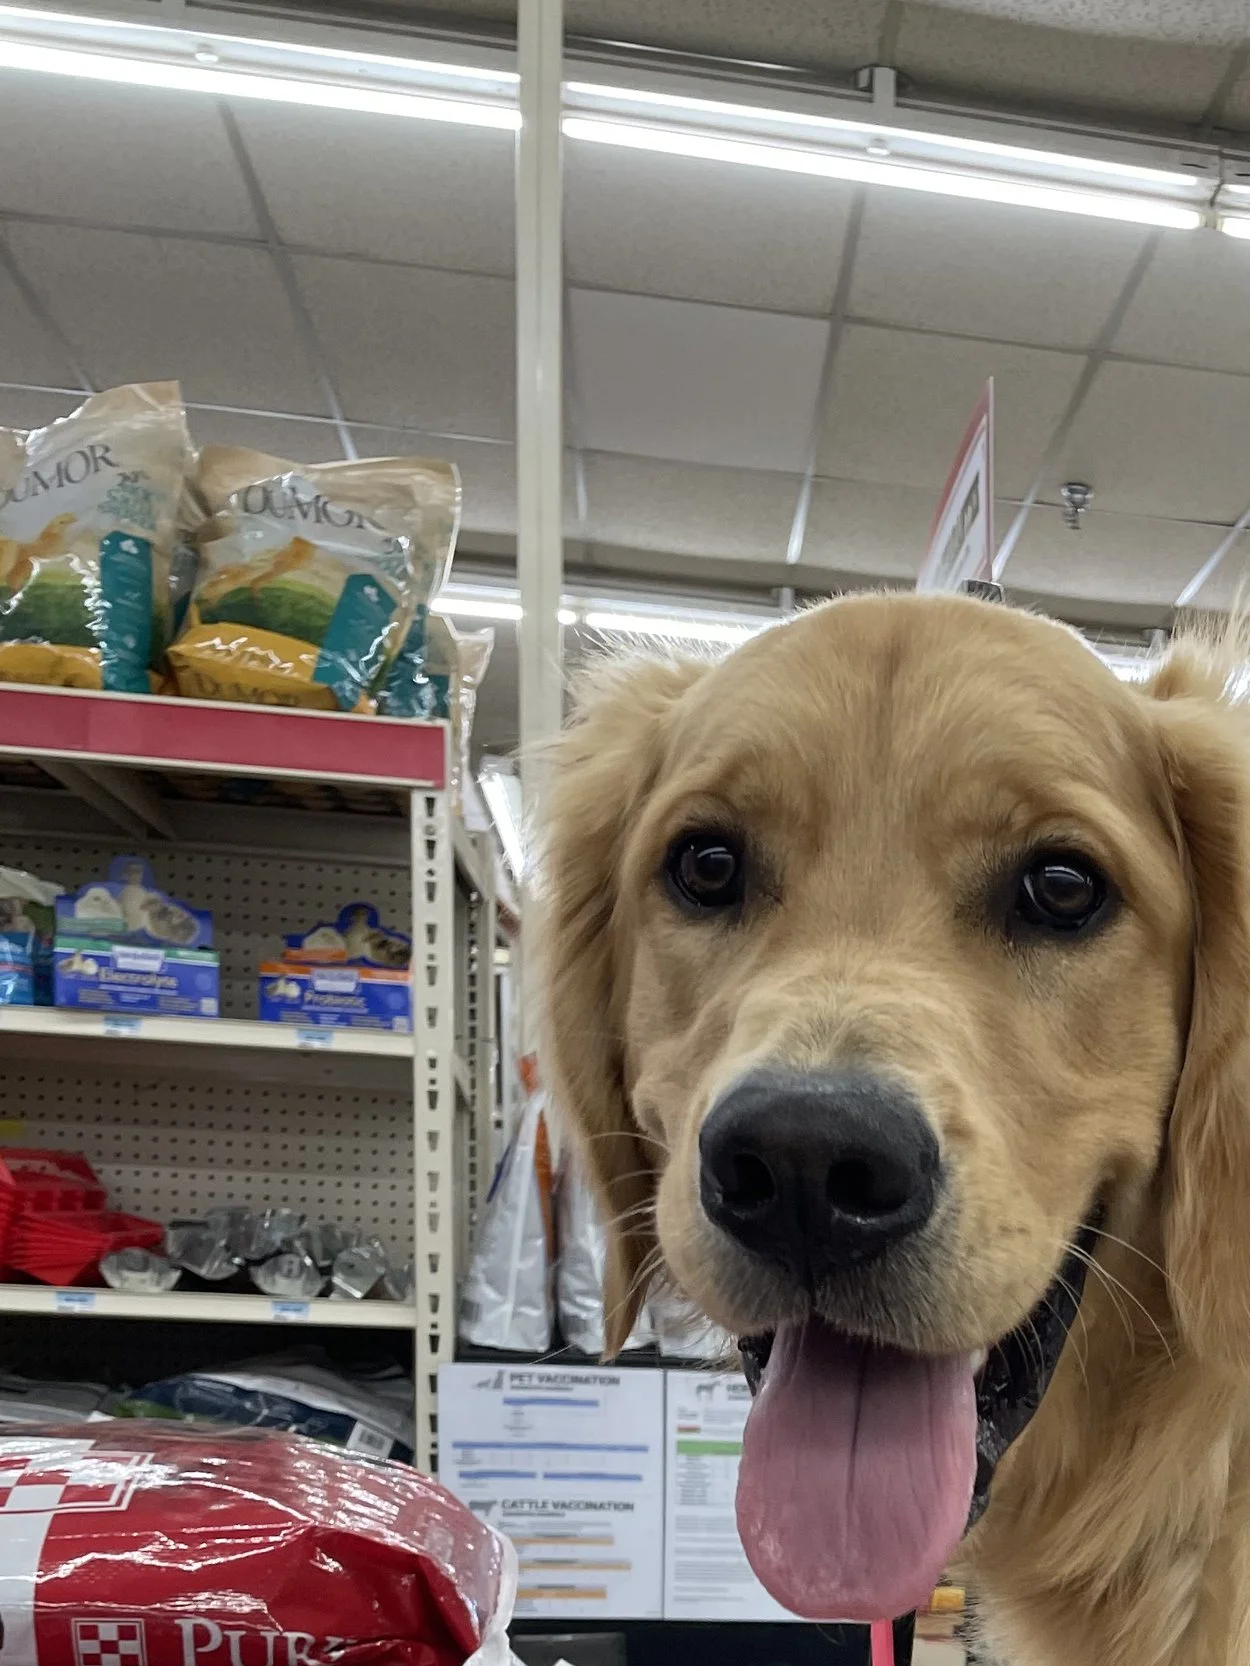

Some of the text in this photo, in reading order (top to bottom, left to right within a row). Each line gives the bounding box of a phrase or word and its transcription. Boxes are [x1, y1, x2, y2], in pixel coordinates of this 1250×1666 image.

[7, 443, 121, 505] UMOR
[509, 1373, 621, 1388] PET VACCINATION
[501, 1499, 635, 1514] CATTLE VACCINATION
